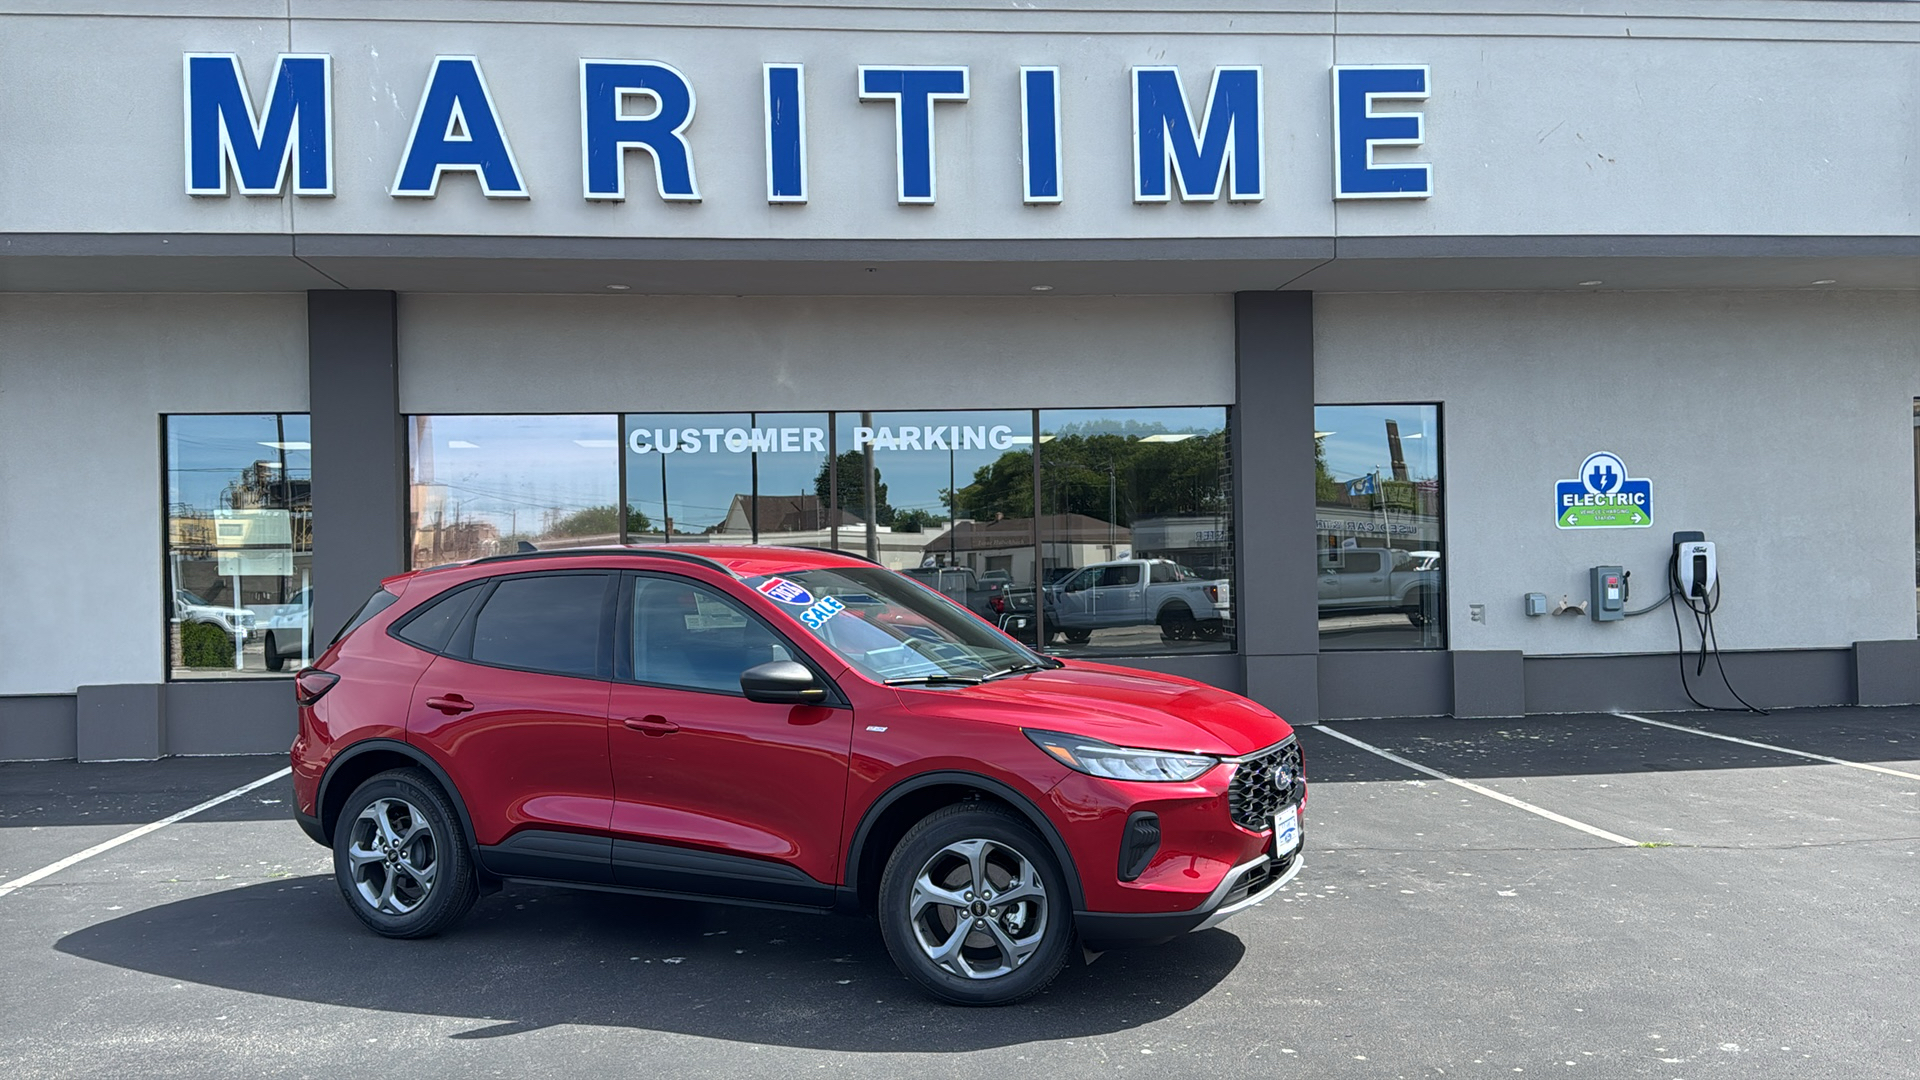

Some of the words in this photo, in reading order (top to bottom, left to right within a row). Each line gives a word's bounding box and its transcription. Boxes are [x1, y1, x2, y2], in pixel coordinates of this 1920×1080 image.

[183, 51, 1432, 205] MARITIME
[629, 427, 826, 455] CUSTOMER
[853, 424, 1013, 452] PARKING
[1562, 492, 1646, 507] ELECTRIC
[800, 596, 845, 629] SALE
